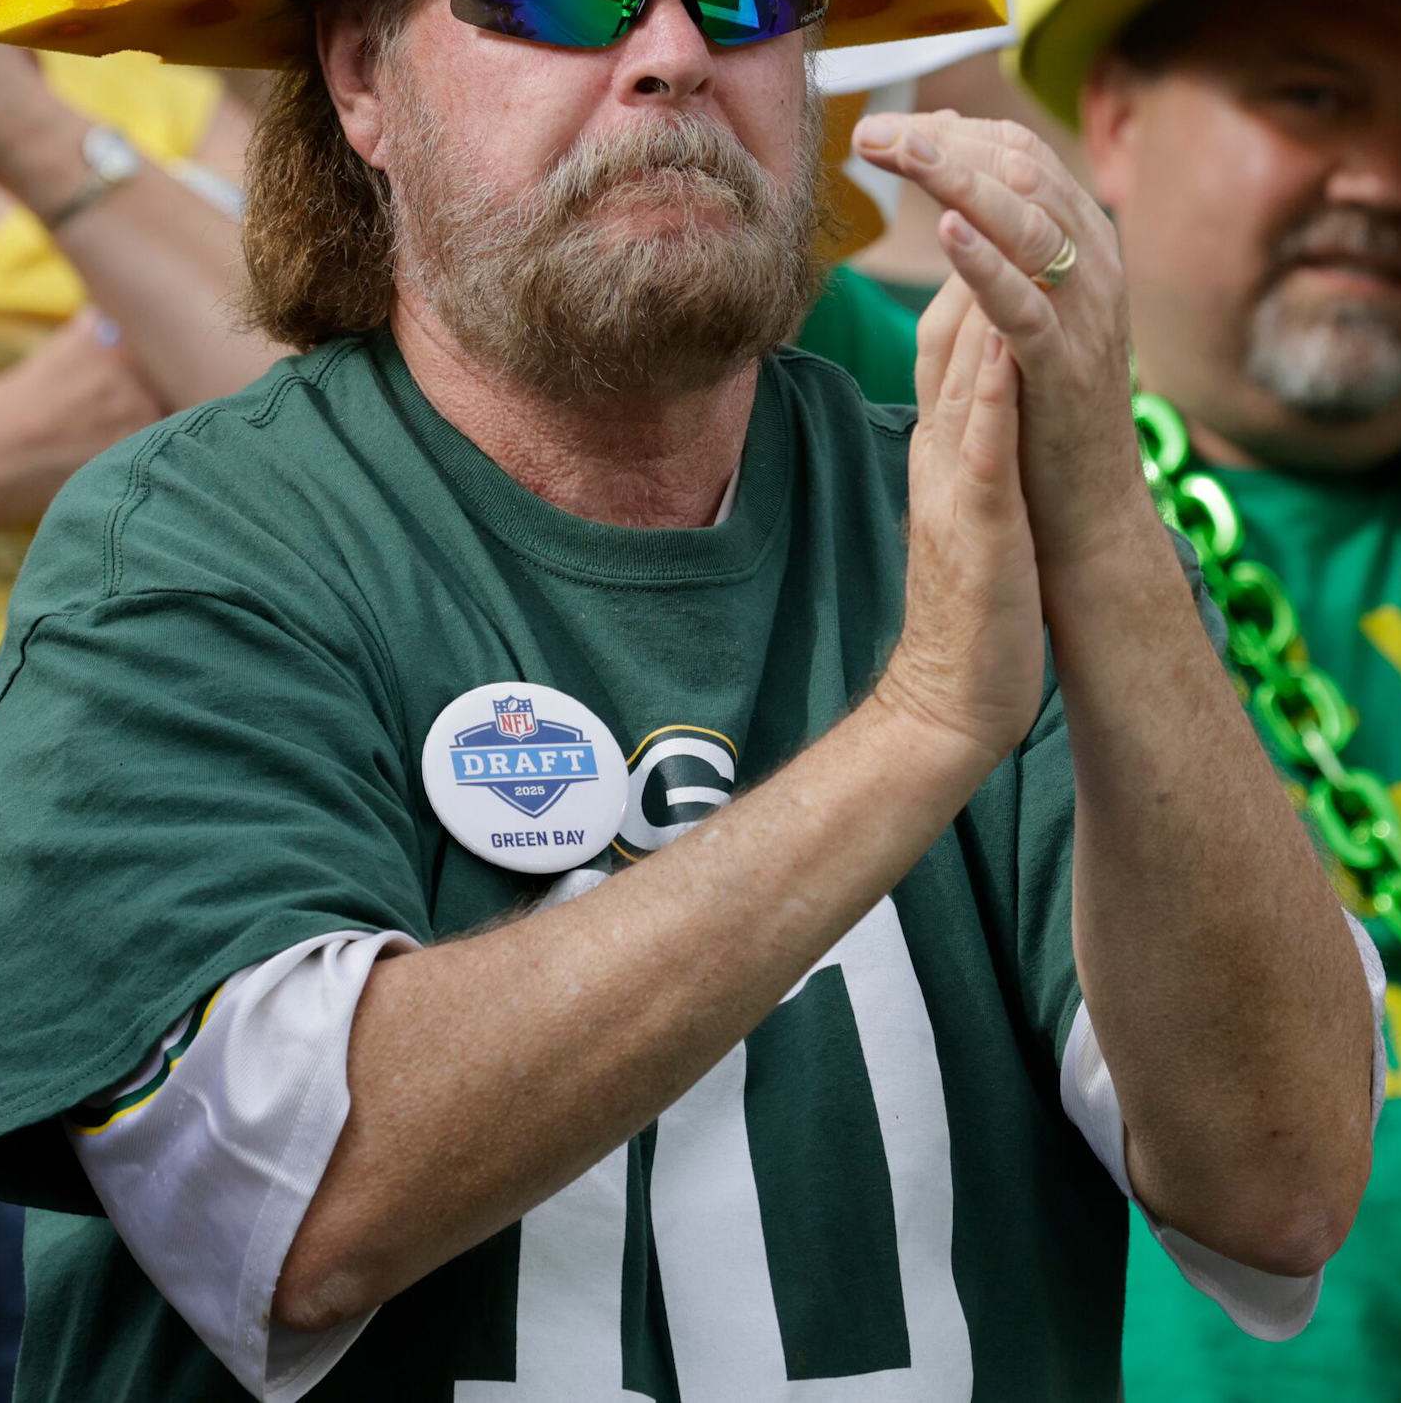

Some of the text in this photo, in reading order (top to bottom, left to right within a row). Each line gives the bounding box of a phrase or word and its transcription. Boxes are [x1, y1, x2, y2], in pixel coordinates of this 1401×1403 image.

[499, 712, 534, 735] NFL
[461, 749, 586, 776] DRAFT
[513, 784, 547, 797] 2025
[490, 829, 586, 849] GREEN BAY
